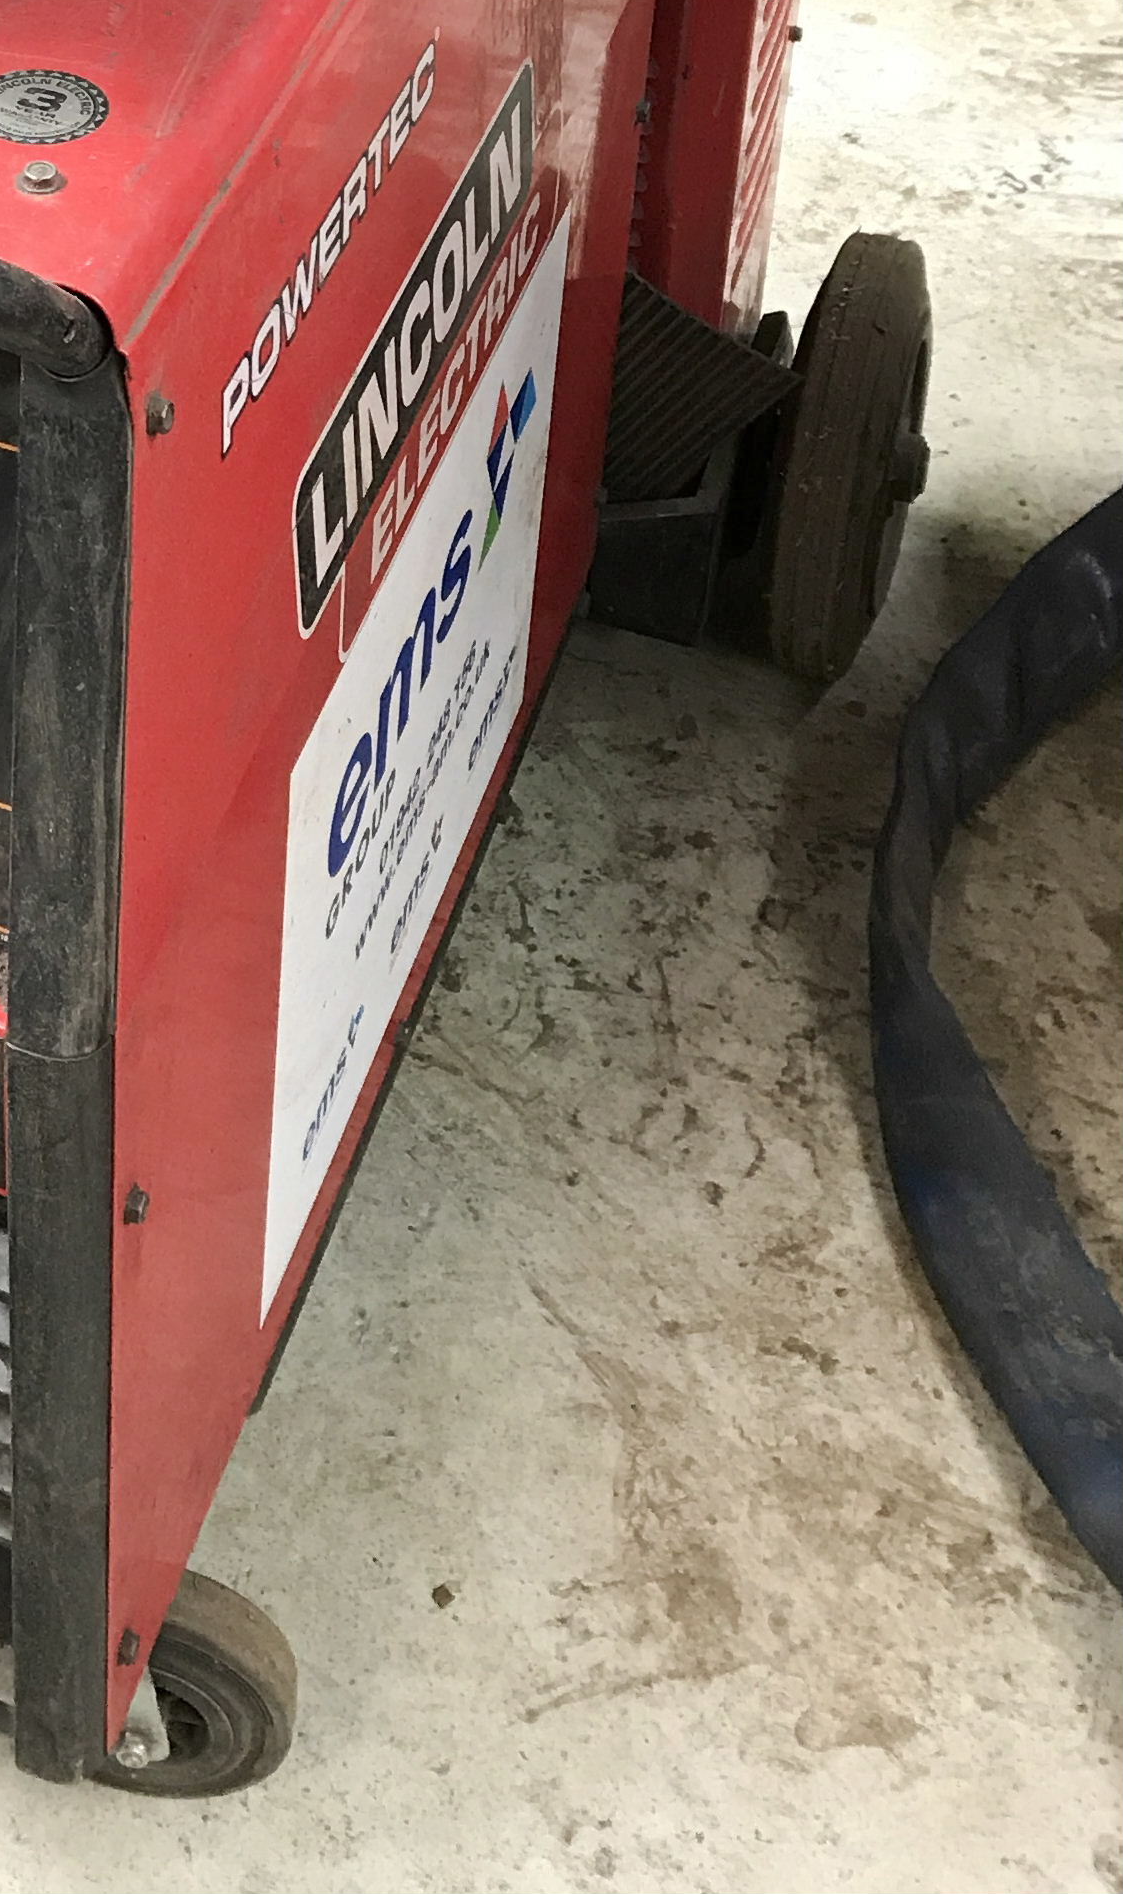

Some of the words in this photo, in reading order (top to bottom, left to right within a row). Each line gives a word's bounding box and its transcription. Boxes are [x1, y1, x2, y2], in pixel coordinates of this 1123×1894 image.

[17, 87, 67, 112] 3
[56, 80, 93, 116] ELECTRIC
[221, 40, 437, 460] POWERTEC
[312, 101, 524, 590] LINCOLN
[370, 192, 541, 586] ELECTRIC
[328, 508, 474, 879] ems
[468, 677, 504, 772] ems
[326, 767, 396, 940] GROUP
[390, 850, 431, 955] ems
[302, 1046, 348, 1162] ems
